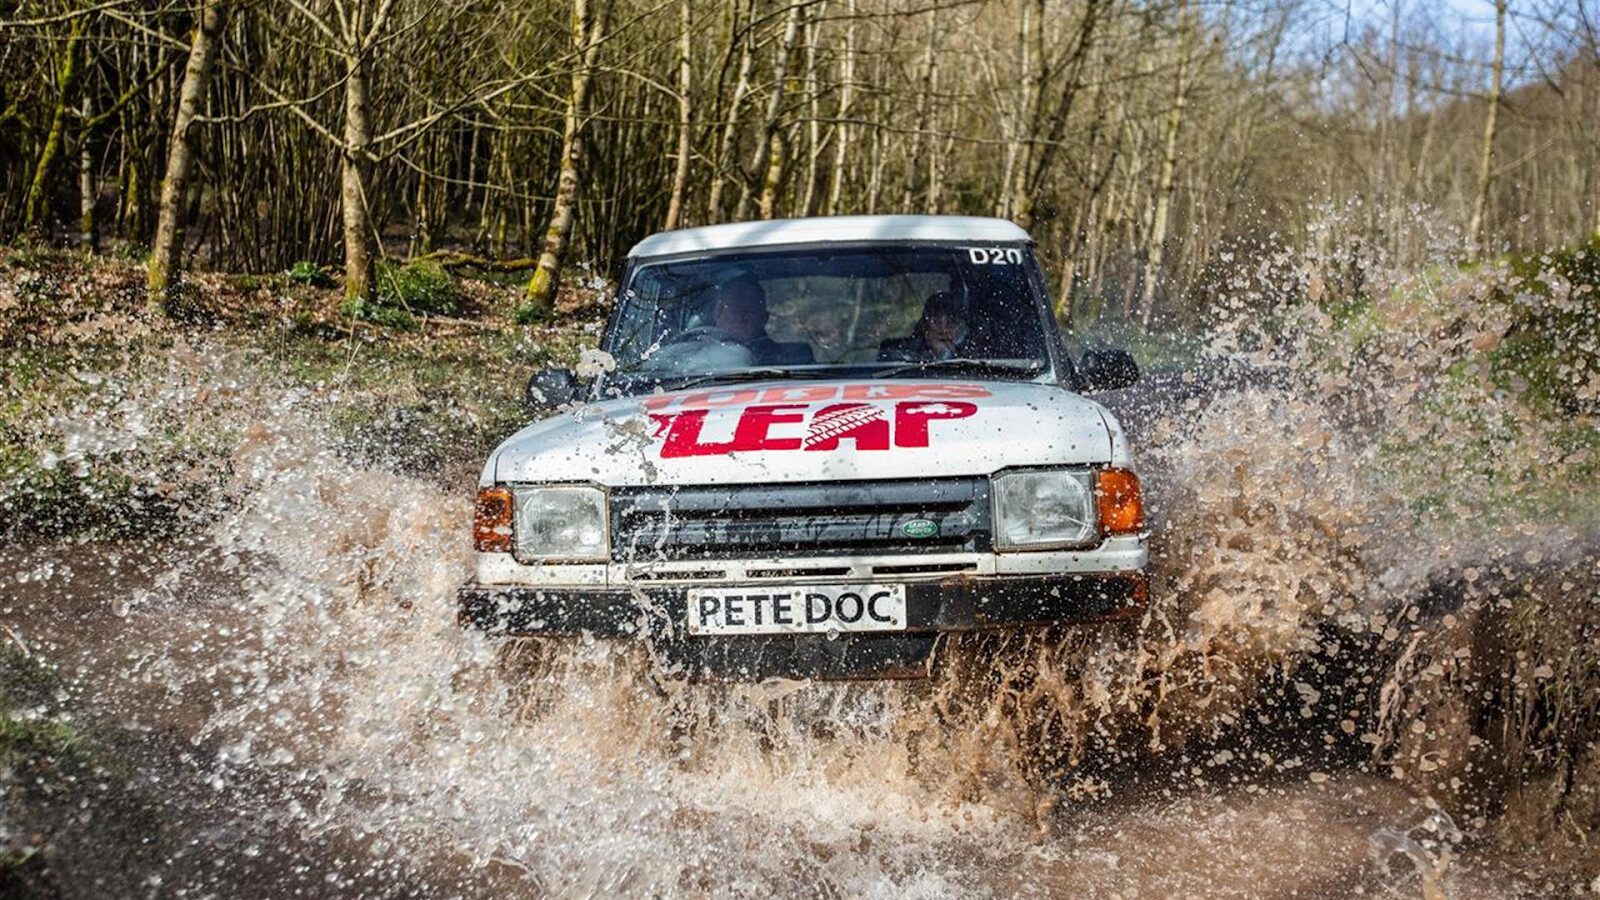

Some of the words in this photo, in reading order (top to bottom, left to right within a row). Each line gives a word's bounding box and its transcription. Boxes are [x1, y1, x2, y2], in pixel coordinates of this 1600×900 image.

[968, 248, 1022, 265] D20
[660, 401, 978, 459] LEAP
[700, 594, 793, 627] PETE
[805, 591, 892, 625] DOC
